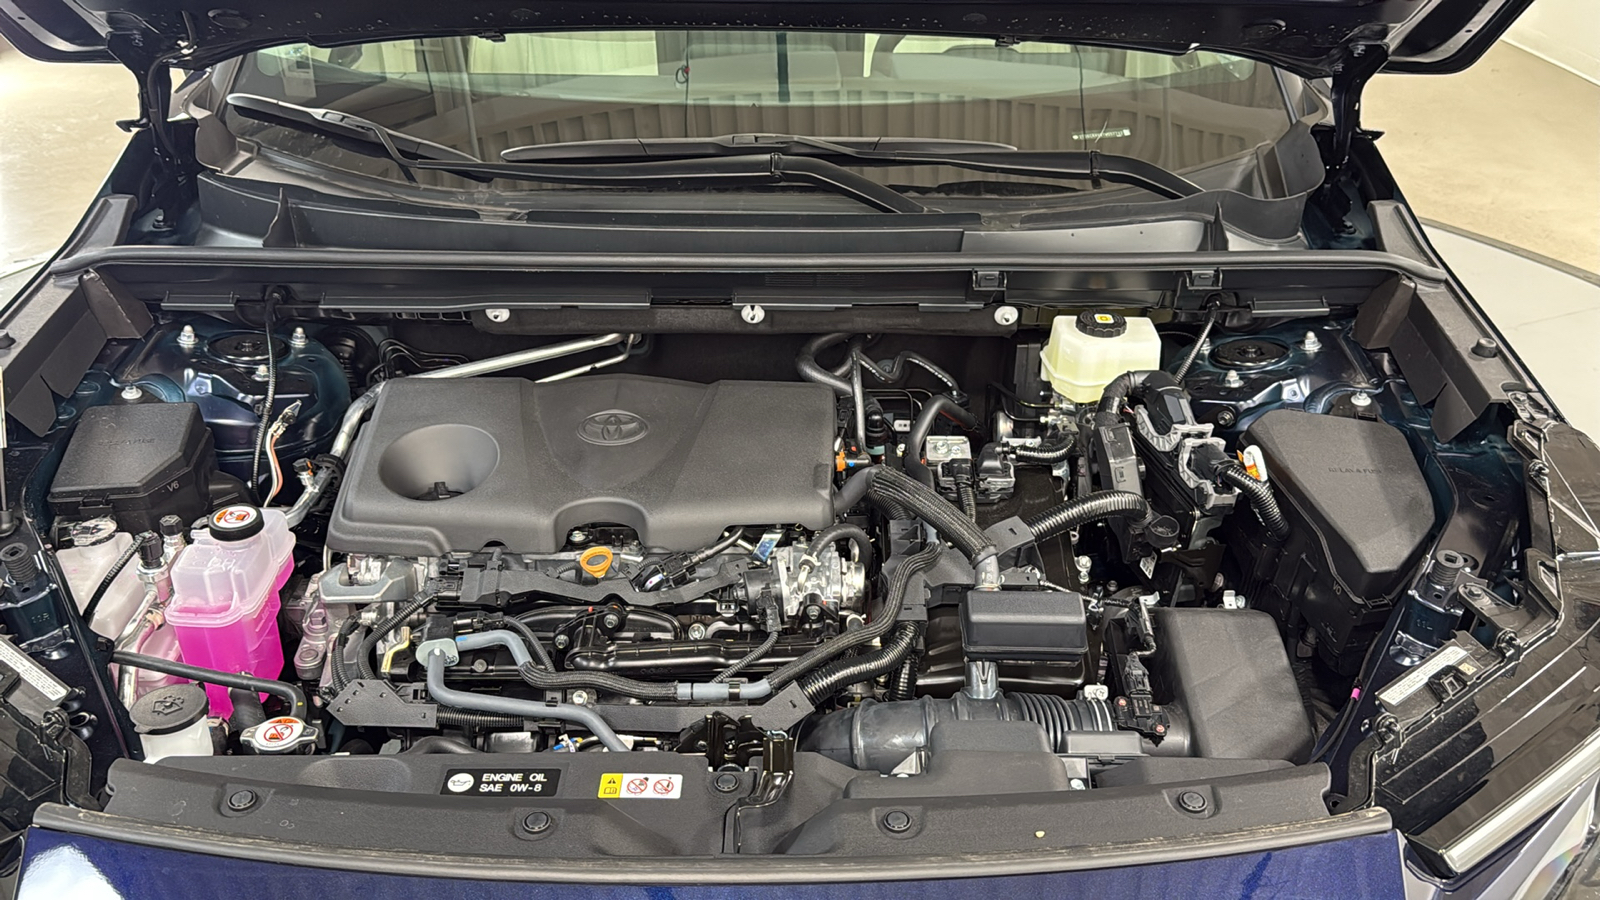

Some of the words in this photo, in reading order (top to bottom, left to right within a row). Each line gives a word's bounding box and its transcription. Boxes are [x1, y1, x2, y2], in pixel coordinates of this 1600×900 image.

[482, 773, 523, 782] ENGINE
[529, 773, 548, 782] OIL
[479, 783, 503, 792] SAE
[509, 783, 542, 792] 0W-8
